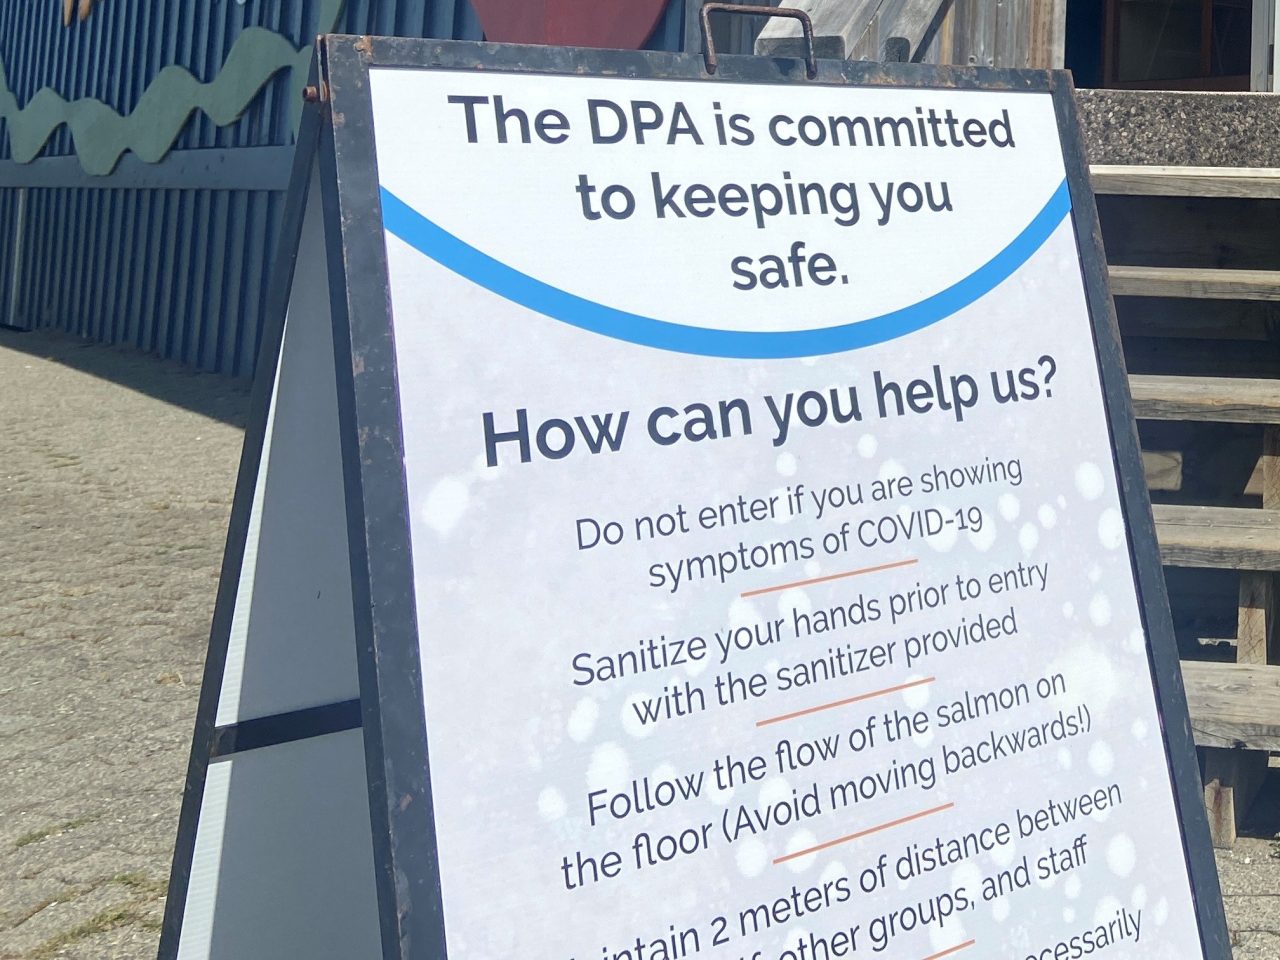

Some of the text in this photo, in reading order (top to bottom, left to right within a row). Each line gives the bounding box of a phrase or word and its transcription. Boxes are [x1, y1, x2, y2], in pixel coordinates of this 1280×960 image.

[446, 93, 1017, 149] The DPA is committed
[574, 170, 954, 230] to keeping you
[729, 239, 850, 292] safe.
[481, 353, 1058, 469] How can you help us?
[575, 456, 1024, 552] Do not enter if you are showing
[648, 505, 984, 595] symptoms of COVID-19
[571, 561, 1049, 687] Sanitize your hands prior to entry
[631, 605, 1019, 726] with the sanitizer provided
[559, 703, 1092, 891] the floor (Avoid moving backwards!)
[587, 672, 1067, 828] Follow the flow of the salmon on
[709, 915, 731, 948] 2
[738, 876, 852, 938] meters
[858, 853, 888, 894] of
[894, 821, 1011, 882] distance
[1015, 783, 1123, 840] between
[868, 886, 978, 954] groups,
[981, 854, 1032, 902] and
[1036, 832, 1089, 881] staff
